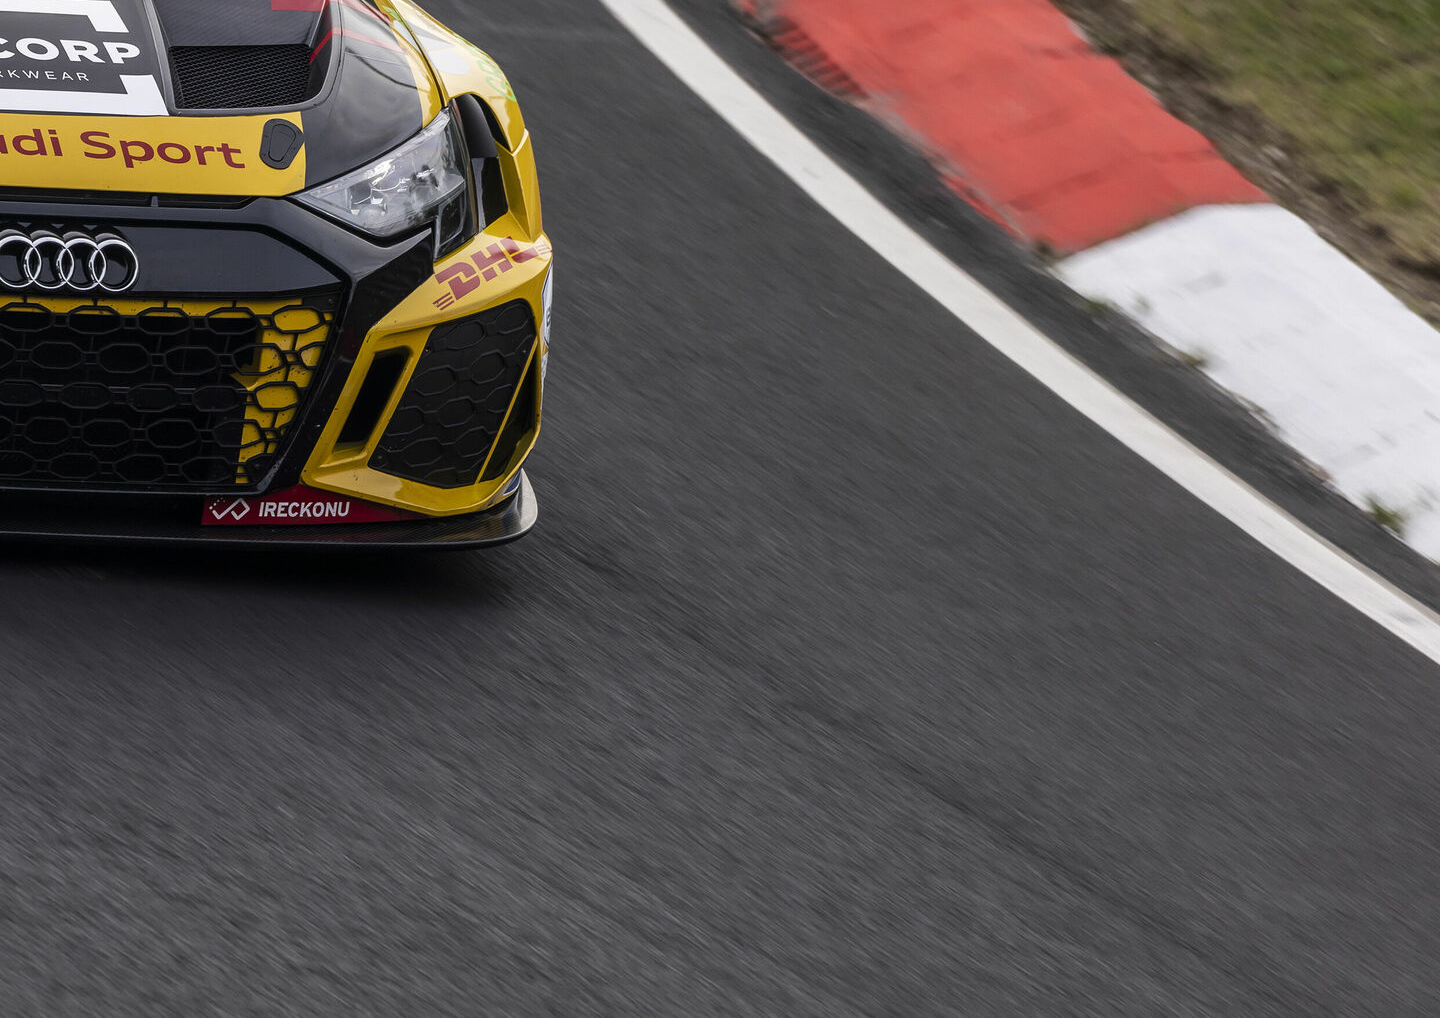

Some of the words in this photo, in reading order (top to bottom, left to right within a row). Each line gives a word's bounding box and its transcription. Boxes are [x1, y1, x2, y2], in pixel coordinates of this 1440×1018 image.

[79, 131, 246, 169] Sport
[435, 236, 541, 301] DHL
[258, 501, 350, 518] IRECKONU
